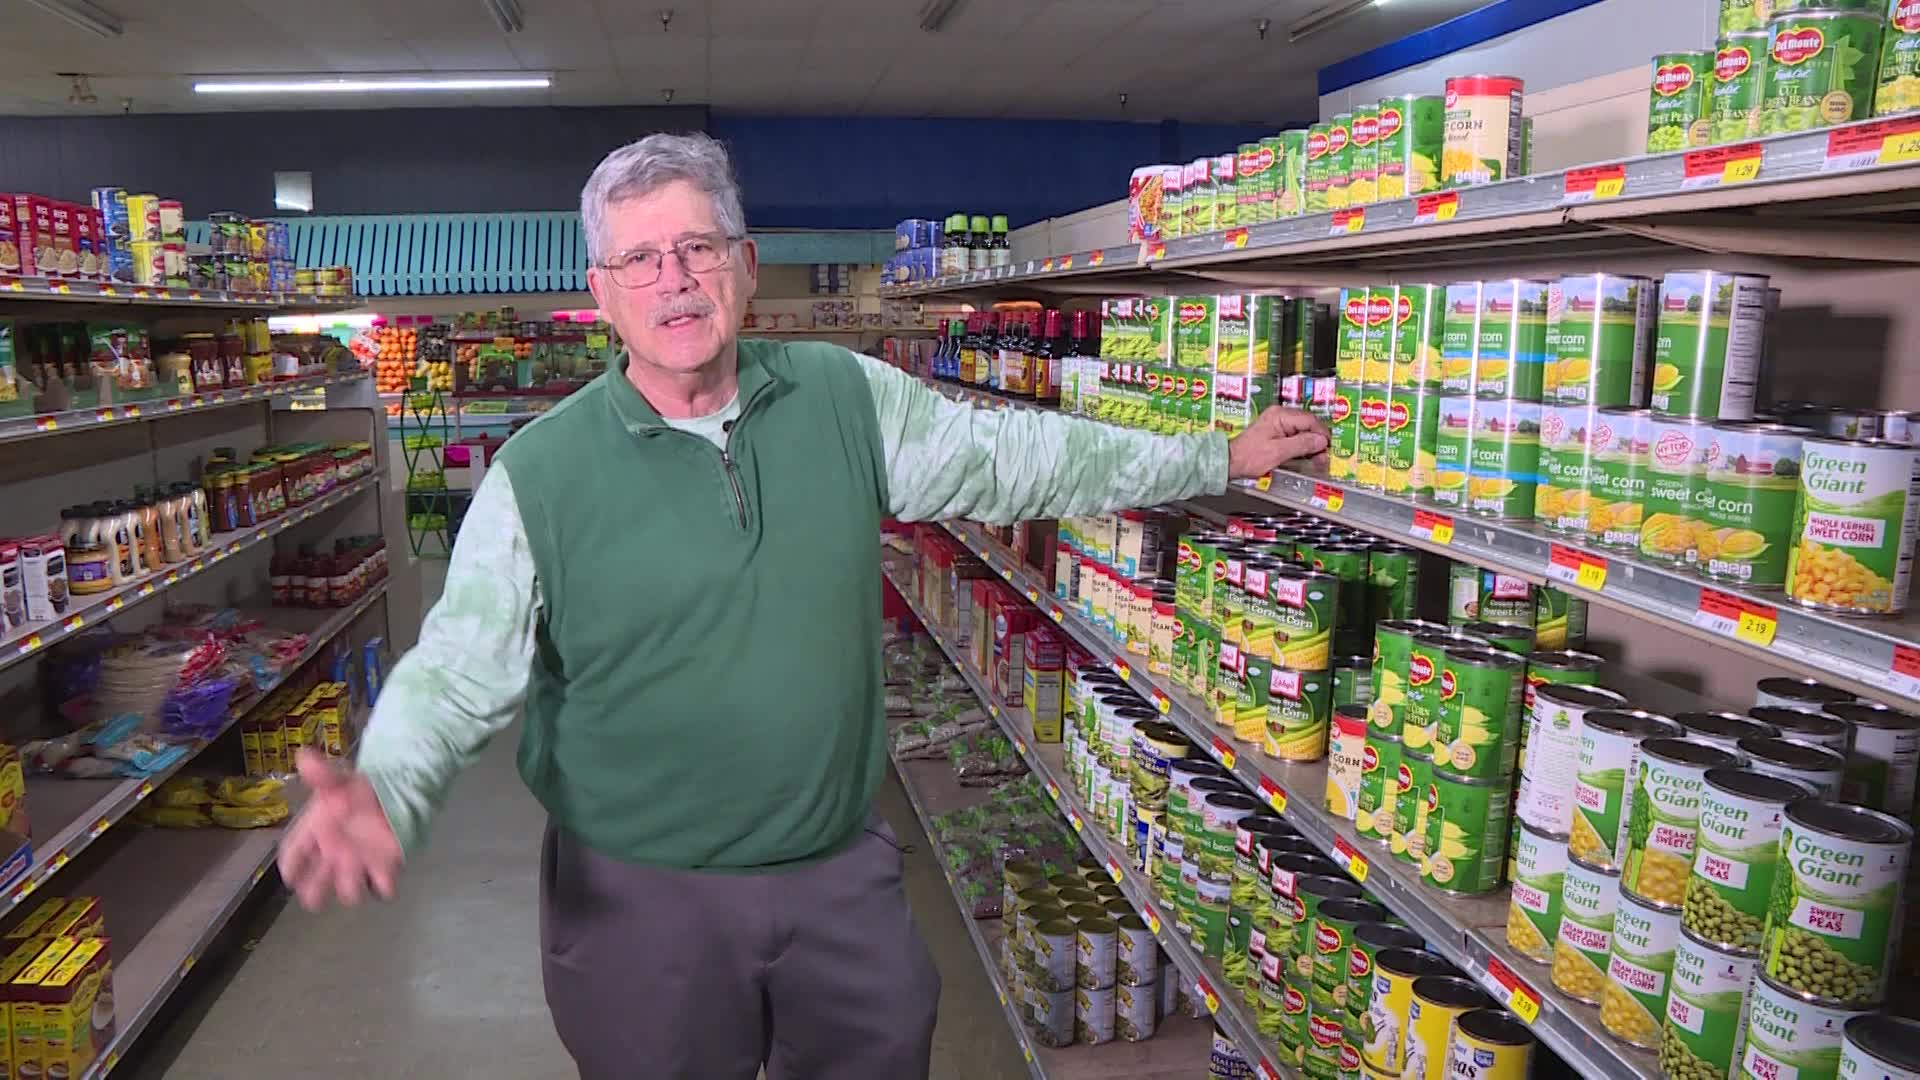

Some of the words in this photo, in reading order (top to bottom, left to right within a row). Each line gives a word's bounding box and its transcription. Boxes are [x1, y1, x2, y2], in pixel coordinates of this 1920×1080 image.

[1788, 37, 1820, 51] Monte
[1450, 120, 1483, 130] CORN
[1447, 331, 1467, 342] corn
[1482, 331, 1503, 342] corn
[1562, 334, 1585, 345] corn
[1479, 449, 1505, 462] corn
[1806, 451, 1867, 474] Green
[1563, 463, 1593, 478] corn
[1612, 475, 1645, 489] corn
[1808, 471, 1866, 494] Giant
[1651, 487, 1691, 500] sweet
[1718, 499, 1753, 514] corn
[1811, 516, 1839, 528] WHOLE
[1841, 519, 1876, 532] KERNEL
[1810, 526, 1840, 539] SWEET
[1841, 531, 1875, 543] CORN
[1286, 616, 1313, 630] Corn
[1745, 619, 1767, 634] 2.19
[1282, 707, 1309, 721] Corn
[1332, 753, 1361, 767] CORN
[1650, 767, 1702, 792] Green
[1654, 787, 1699, 809] Gian
[1701, 790, 1749, 822] Green
[1657, 826, 1687, 840] CREAM
[1701, 810, 1745, 840] Giant
[1655, 835, 1684, 849] SWEET
[1795, 834, 1865, 868] Green
[1706, 855, 1732, 872] SWEET
[1704, 864, 1729, 881] PEAS
[1798, 857, 1865, 888] Giant
[1564, 884, 1601, 911] Giant
[1810, 905, 1845, 922] SWEET
[1808, 915, 1842, 932] PEAS
[1585, 928, 1608, 942] STYLE
[1615, 918, 1651, 949] Giant
[1582, 936, 1607, 951] CORN
[1632, 965, 1658, 983] STYLE
[1677, 964, 1705, 987] ant
[1630, 974, 1656, 992] CORN
[1671, 997, 1690, 1014] SWEET
[1750, 990, 1800, 1025] Green
[1670, 1005, 1689, 1025] PEAS
[1751, 1006, 1798, 1043] Giant
[1453, 1058, 1478, 1079] eas
[1753, 1053, 1779, 1072] SWEET
[1752, 1063, 1778, 1080] PEAS
